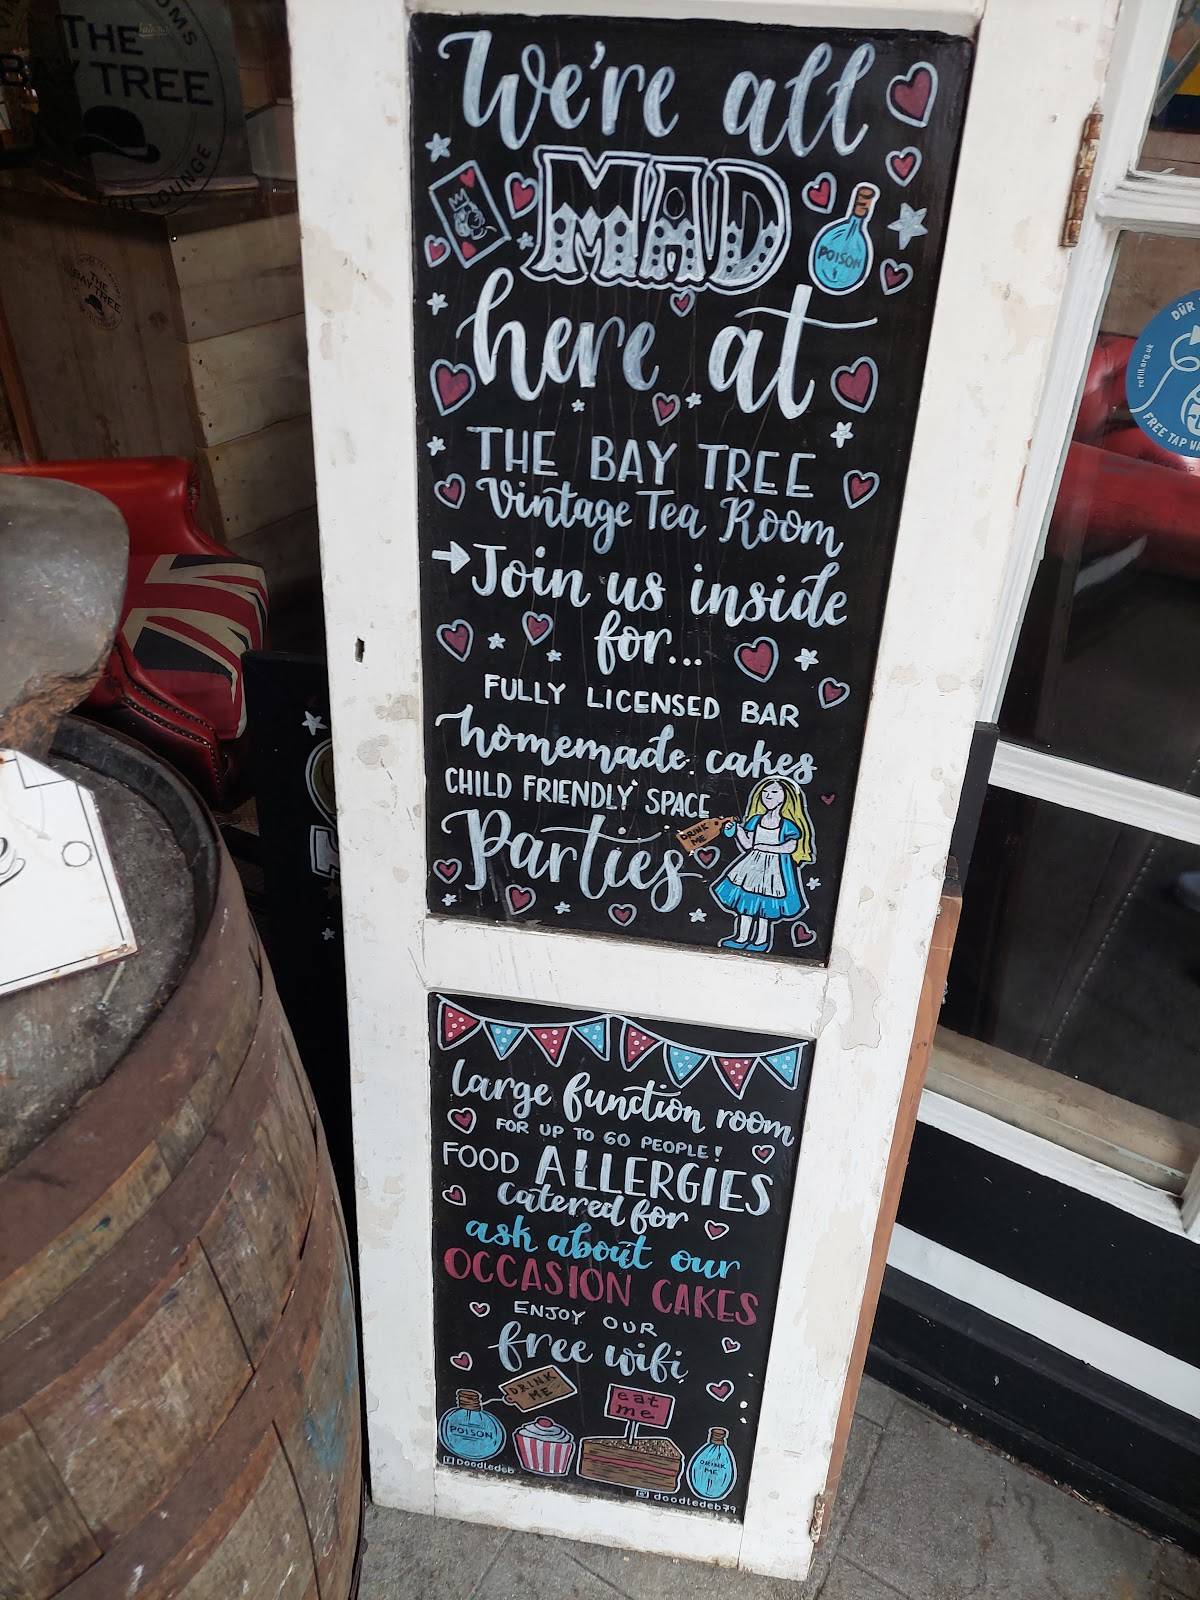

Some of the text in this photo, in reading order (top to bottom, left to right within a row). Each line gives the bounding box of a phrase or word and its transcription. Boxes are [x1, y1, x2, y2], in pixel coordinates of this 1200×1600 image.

[56, 14, 144, 55] THE
[90, 61, 213, 106] TREE
[437, 29, 875, 157] We're all
[146, 144, 212, 208] LOUNGE
[520, 144, 792, 296] MAD
[818, 245, 862, 269] POISON
[455, 267, 878, 420] here at
[1142, 411, 1168, 439] FREE
[1168, 432, 1187, 448] TAP
[466, 426, 817, 498] THE BAY TREE
[475, 476, 845, 559] Vintage Tea Room
[472, 543, 849, 629] Join us inside
[484, 673, 800, 729] FULLY LICENSED BAR
[435, 703, 818, 784] homemade cakes
[445, 766, 711, 819] CHILD FRIENDLY SPACE
[680, 822, 710, 841] DRINK
[691, 834, 707, 846] ME
[440, 808, 704, 914] Parties
[450, 1058, 795, 1147] large function room
[496, 1117, 529, 1135] FOR
[539, 1123, 564, 1139] UP
[573, 1126, 594, 1142] TO
[603, 1131, 631, 1147] 60
[442, 1141, 775, 1217] FOOD ALLERGIES
[630, 1194, 689, 1236] for
[465, 1215, 742, 1280] ask about our
[443, 1247, 760, 1326] OCCASION CAKES
[513, 1300, 658, 1338] ENJOY OUR
[488, 1321, 690, 1384] free wifi
[510, 1371, 558, 1396] DRINK
[529, 1387, 553, 1402] ME
[617, 1390, 660, 1409] eat
[449, 1425, 493, 1440] POISON
[615, 1403, 656, 1420] me
[456, 1458, 515, 1475] Doodledeb
[699, 1459, 727, 1470] DRINK
[653, 1492, 737, 1514] doodledeb79
